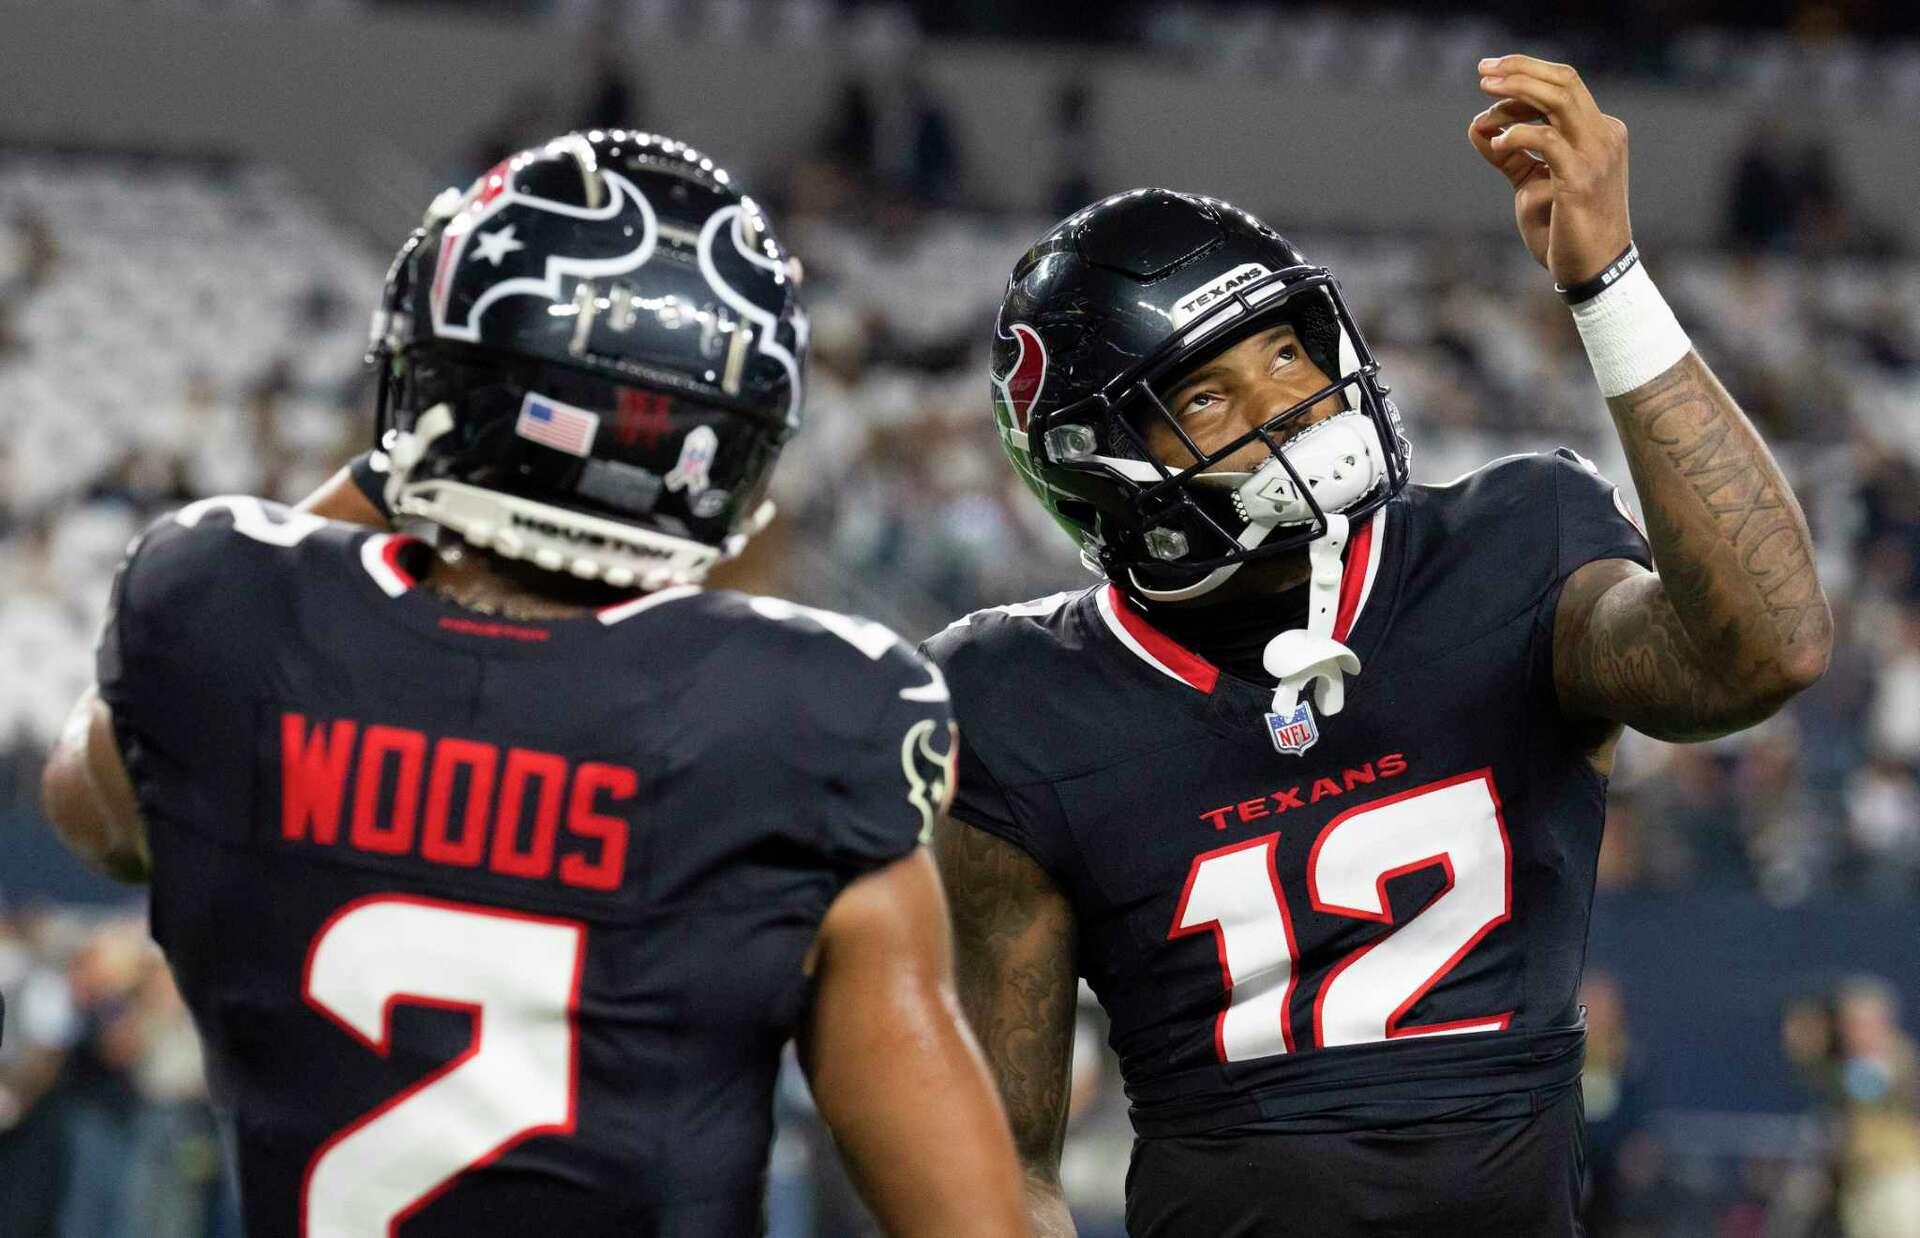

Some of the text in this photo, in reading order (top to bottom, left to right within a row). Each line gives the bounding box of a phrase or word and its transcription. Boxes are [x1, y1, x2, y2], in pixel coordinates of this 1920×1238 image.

[1181, 267, 1263, 313] TEXANS
[1601, 267, 1620, 285] BE
[1278, 723, 1312, 747] NFL
[281, 713, 638, 891] WOODS
[1200, 753, 1409, 831] TEXANS
[1166, 766, 1515, 1064] 12
[301, 893, 587, 1238] 2
